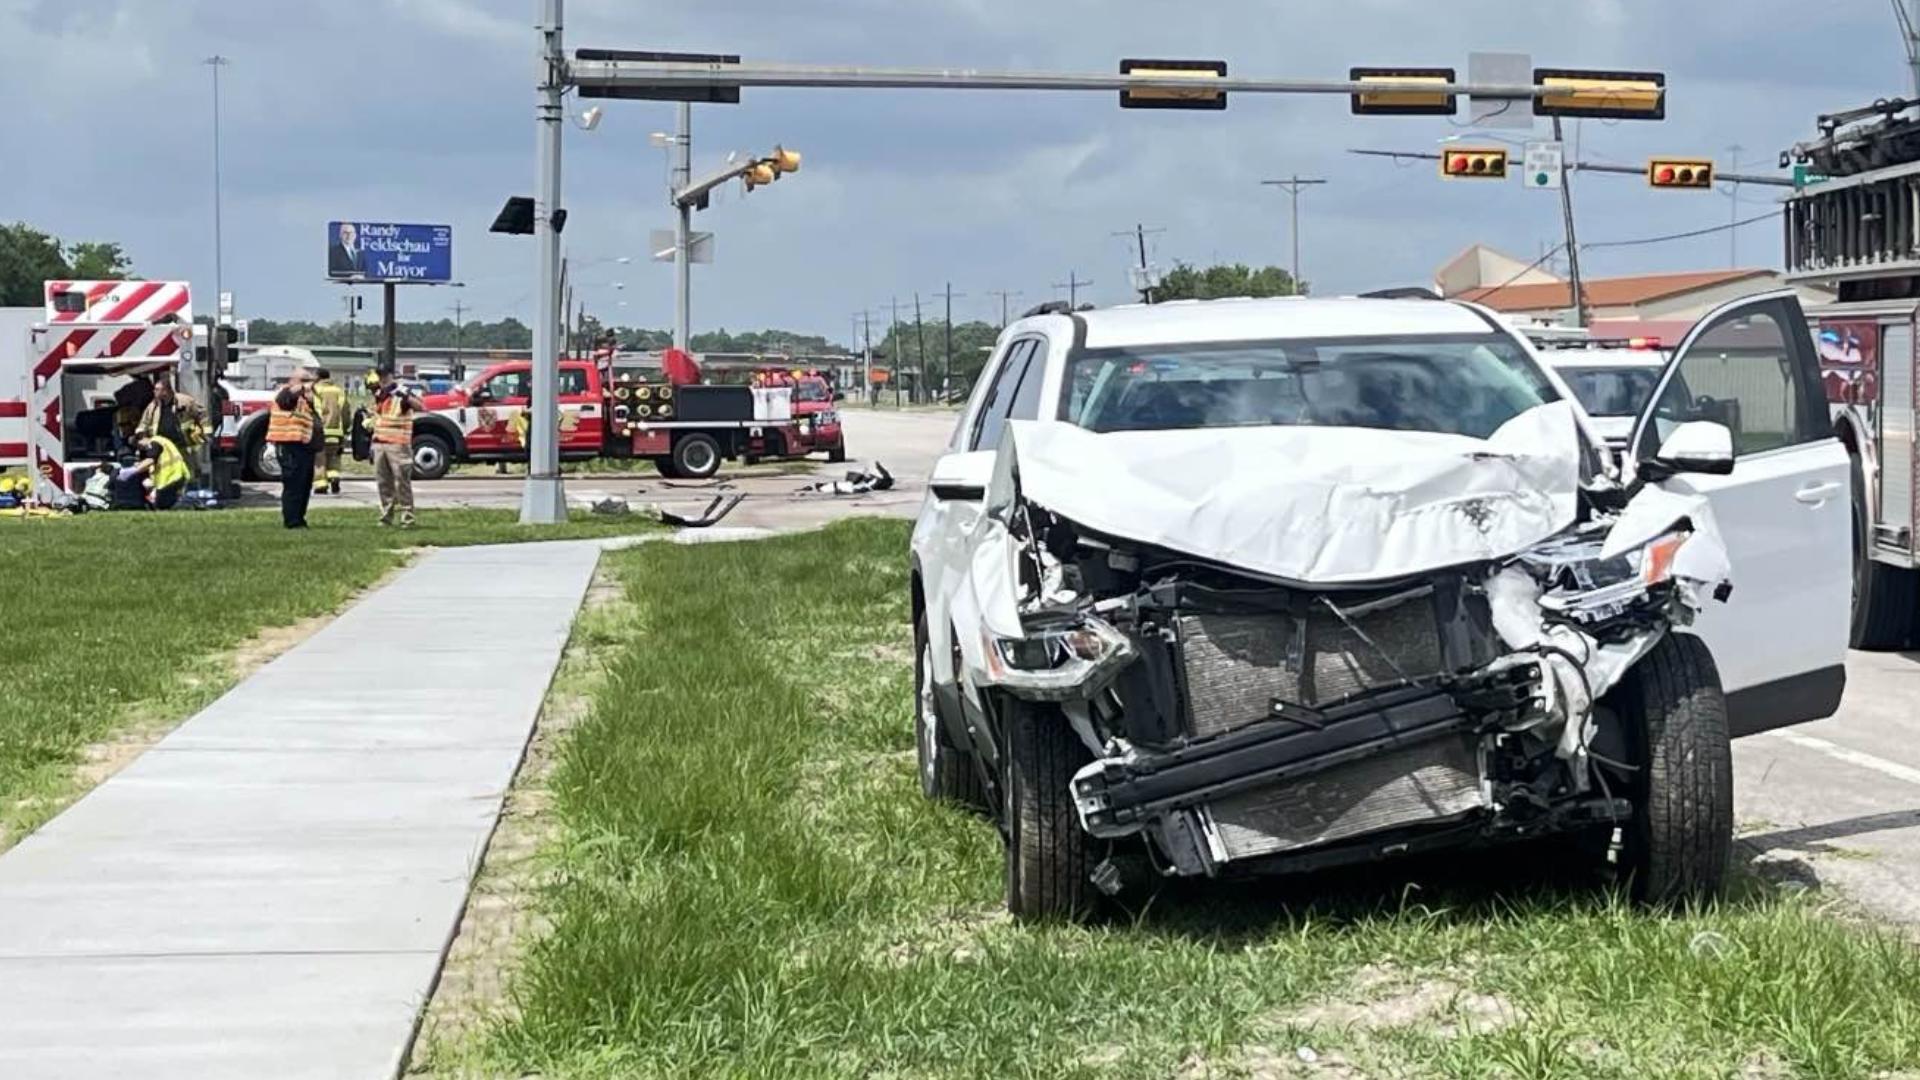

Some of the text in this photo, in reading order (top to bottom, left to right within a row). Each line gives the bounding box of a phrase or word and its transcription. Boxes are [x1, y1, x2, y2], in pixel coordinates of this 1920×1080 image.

[360, 223, 400, 239] Randy
[360, 237, 430, 253] Feldschau
[397, 252, 411, 262] for
[377, 261, 427, 280] Mayor
